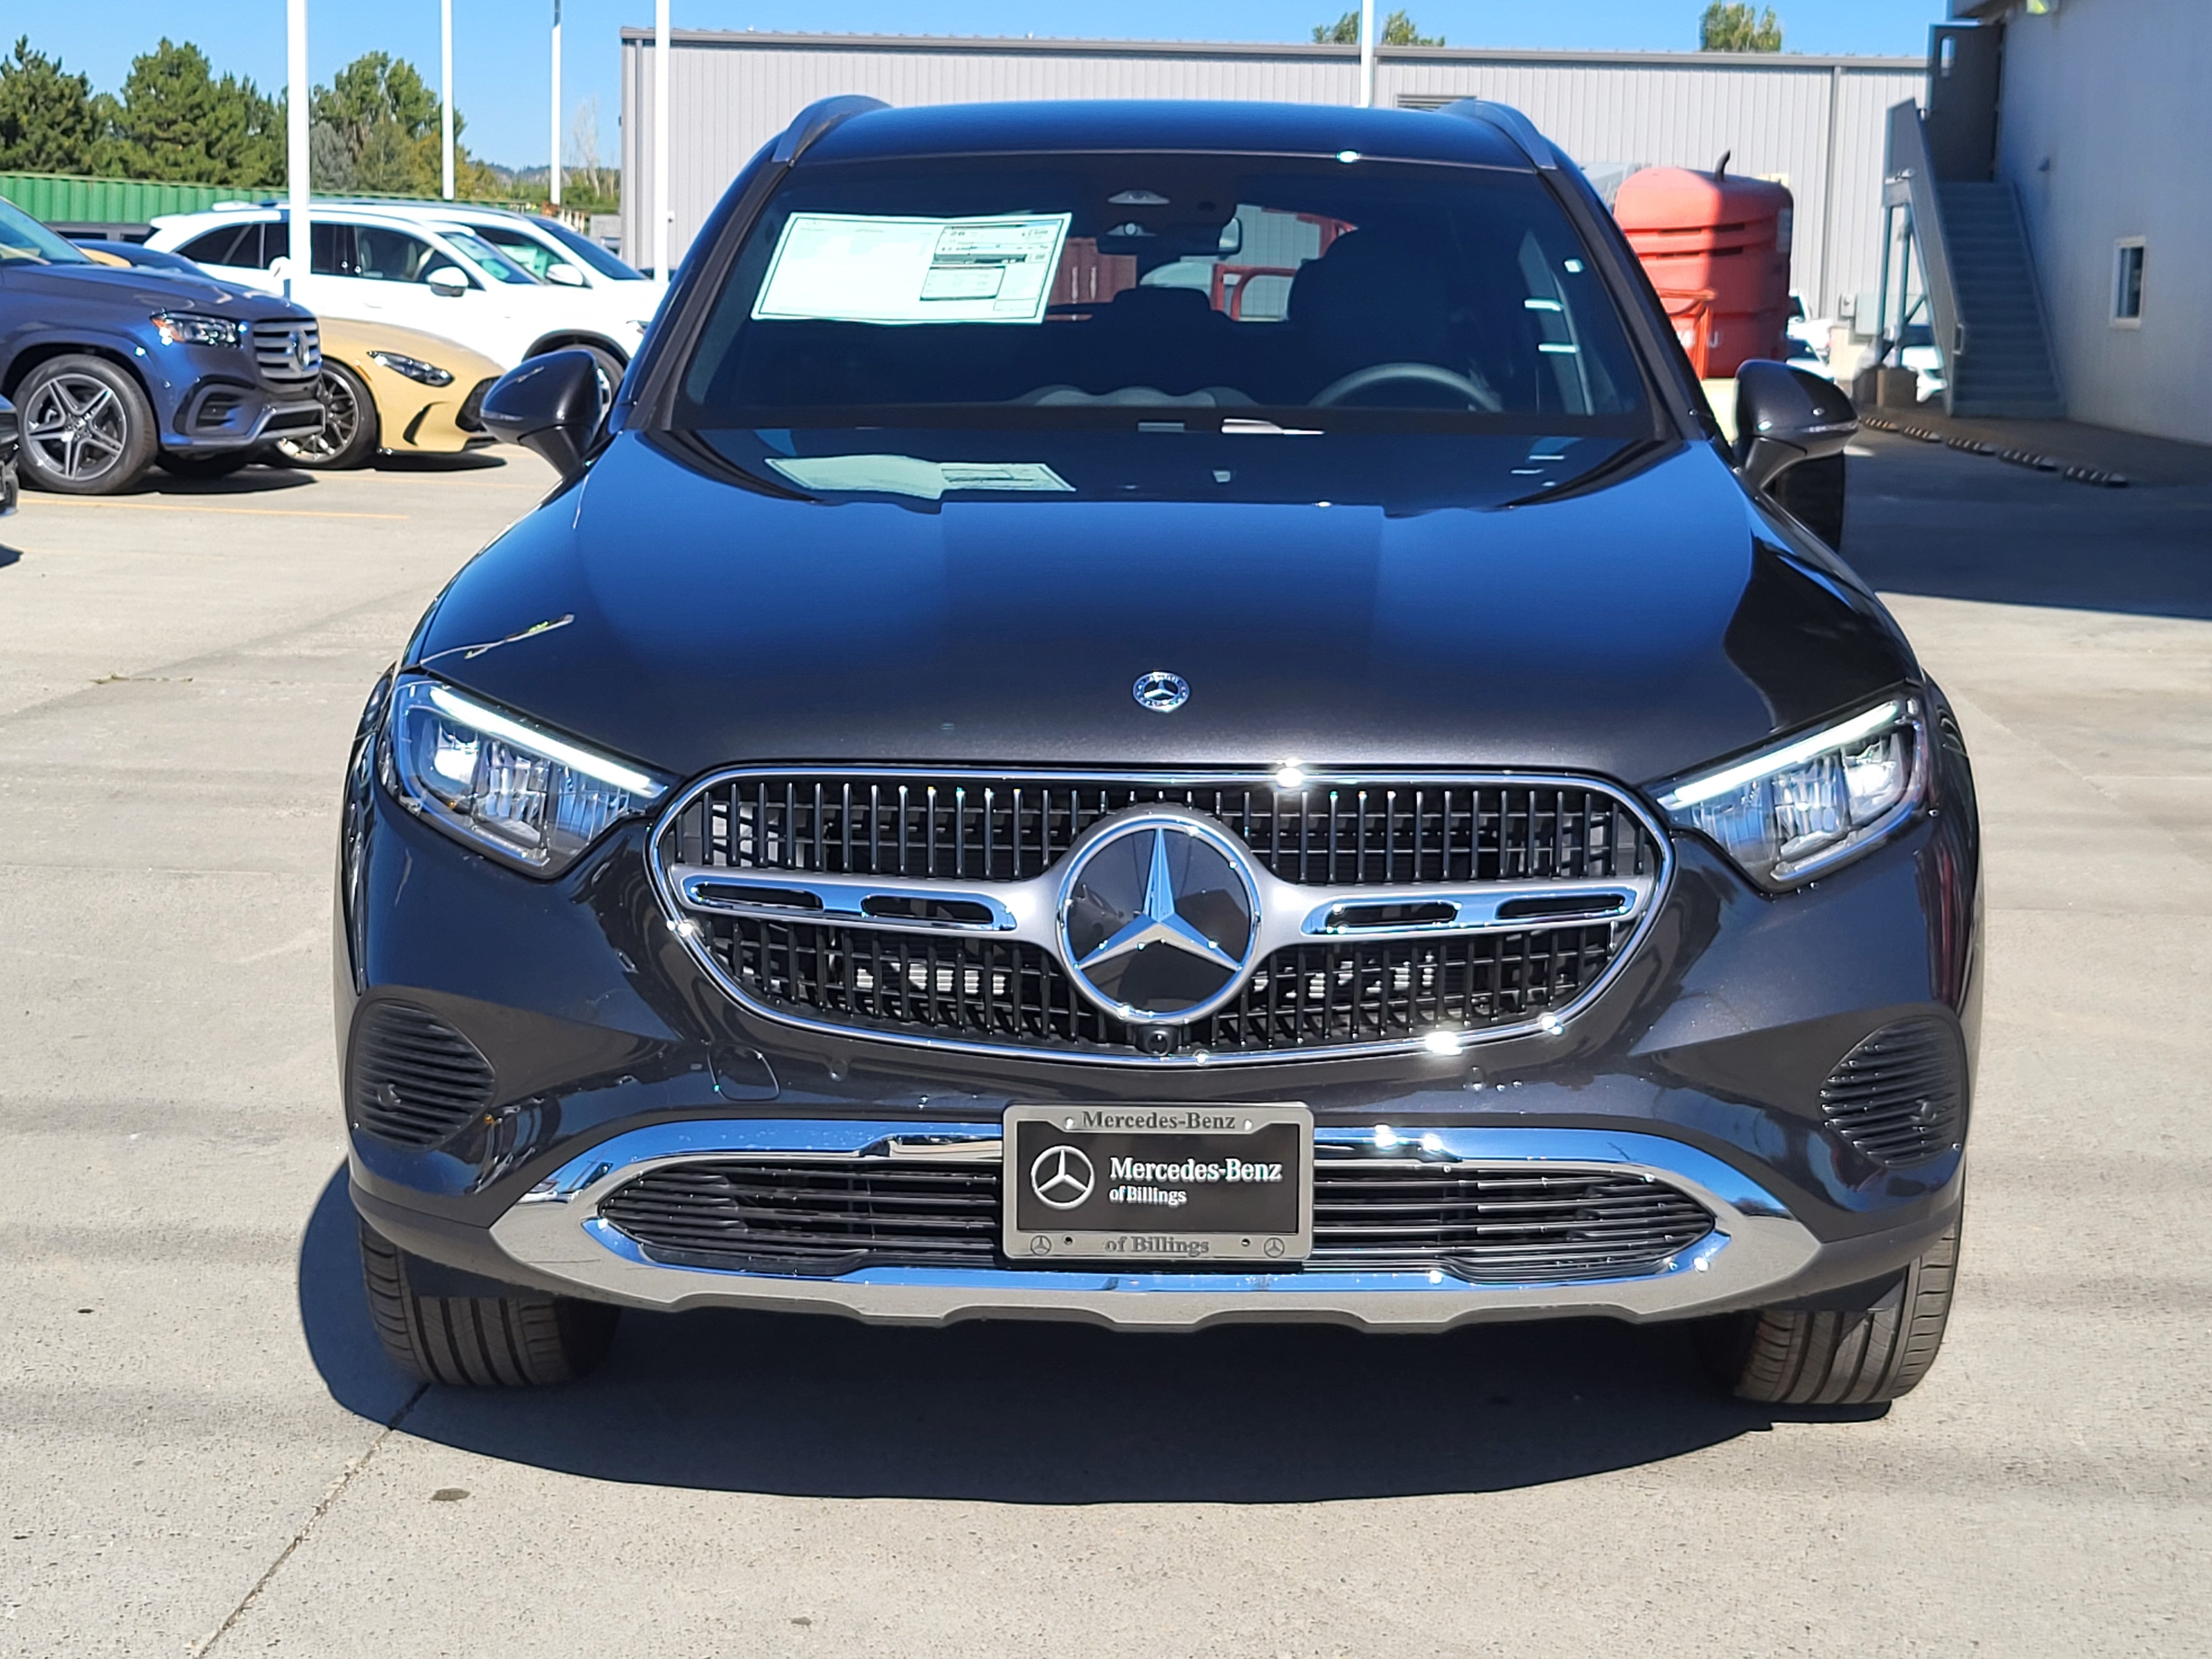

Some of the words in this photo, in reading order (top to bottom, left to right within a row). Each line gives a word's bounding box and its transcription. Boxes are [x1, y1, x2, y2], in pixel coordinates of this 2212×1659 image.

[1082, 1110, 1236, 1130] Mercedes-Benz
[1109, 1157, 1282, 1182] Mercedes-Benz
[1109, 1186, 1126, 1201] of
[1126, 1186, 1187, 1206] Billings
[1104, 1237, 1128, 1253] of
[1130, 1237, 1209, 1255] Billings
